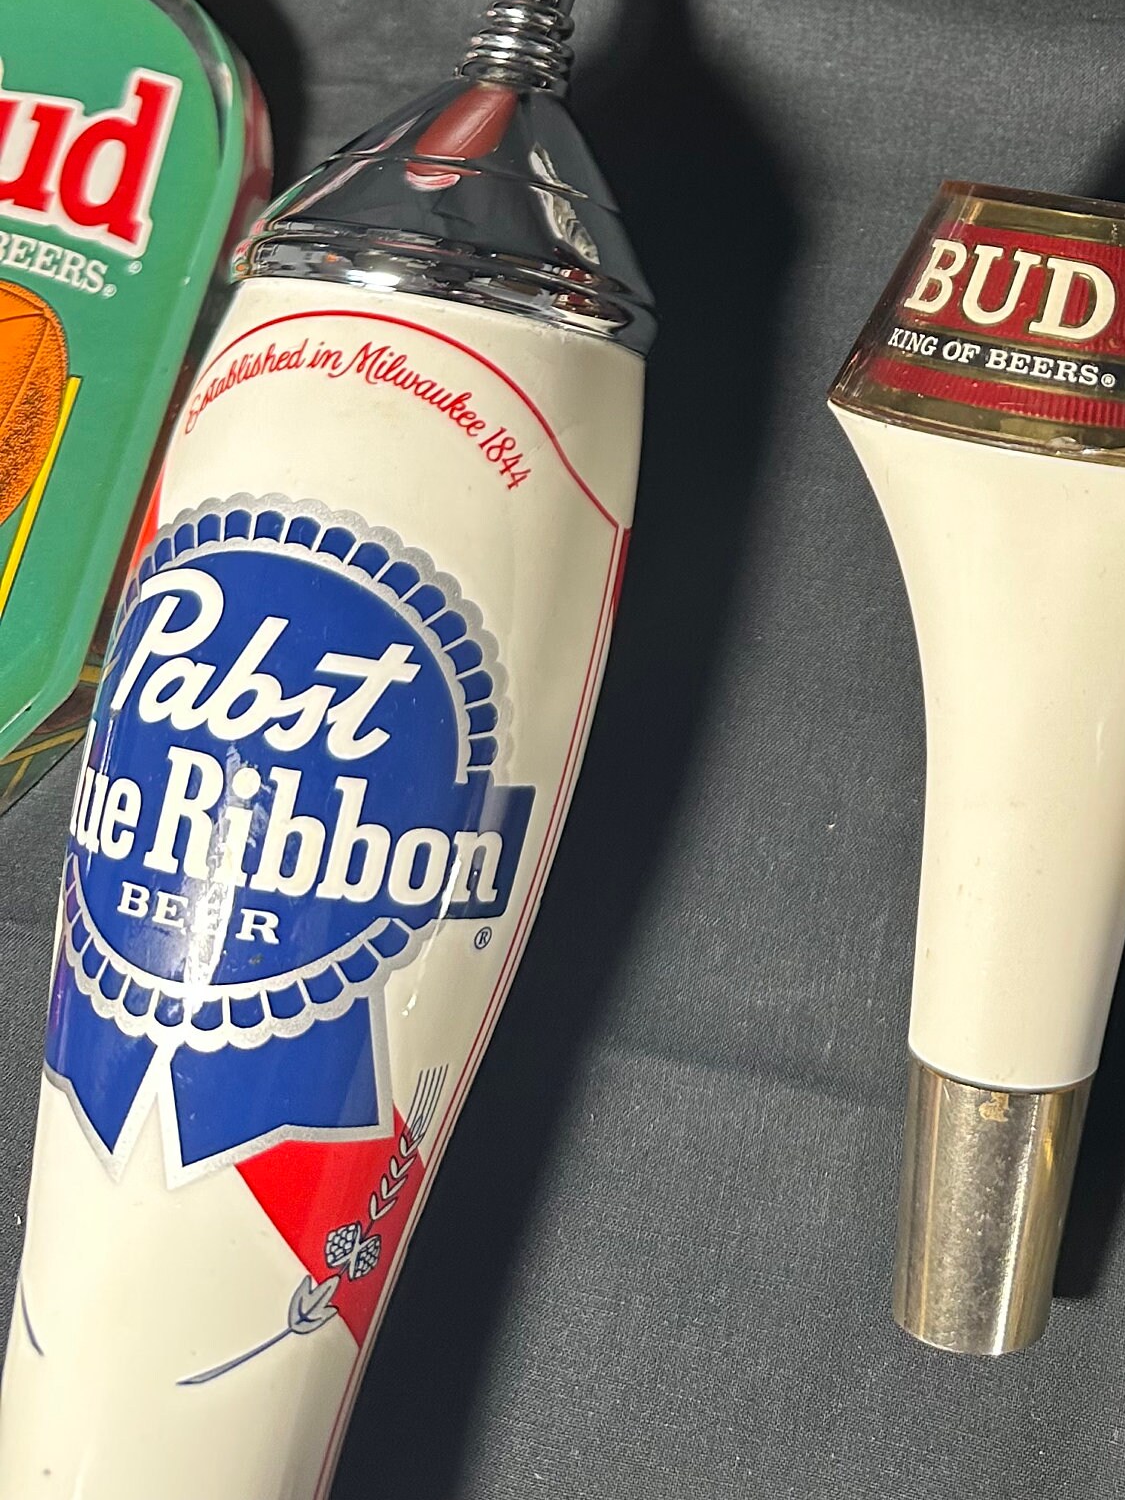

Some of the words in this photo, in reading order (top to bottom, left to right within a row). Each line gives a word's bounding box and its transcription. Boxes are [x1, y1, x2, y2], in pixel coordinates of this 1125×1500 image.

[0, 68, 180, 254] ud
[887, 327, 938, 356] KING
[942, 340, 981, 364] OF
[903, 238, 1117, 341] BUD
[184, 338, 305, 436] Established
[306, 341, 343, 369] in
[327, 341, 486, 438] Milwaukee
[477, 426, 532, 490] 1844
[110, 567, 422, 760] Pabst
[69, 717, 142, 860] lue
[143, 745, 501, 902] Ribbon
